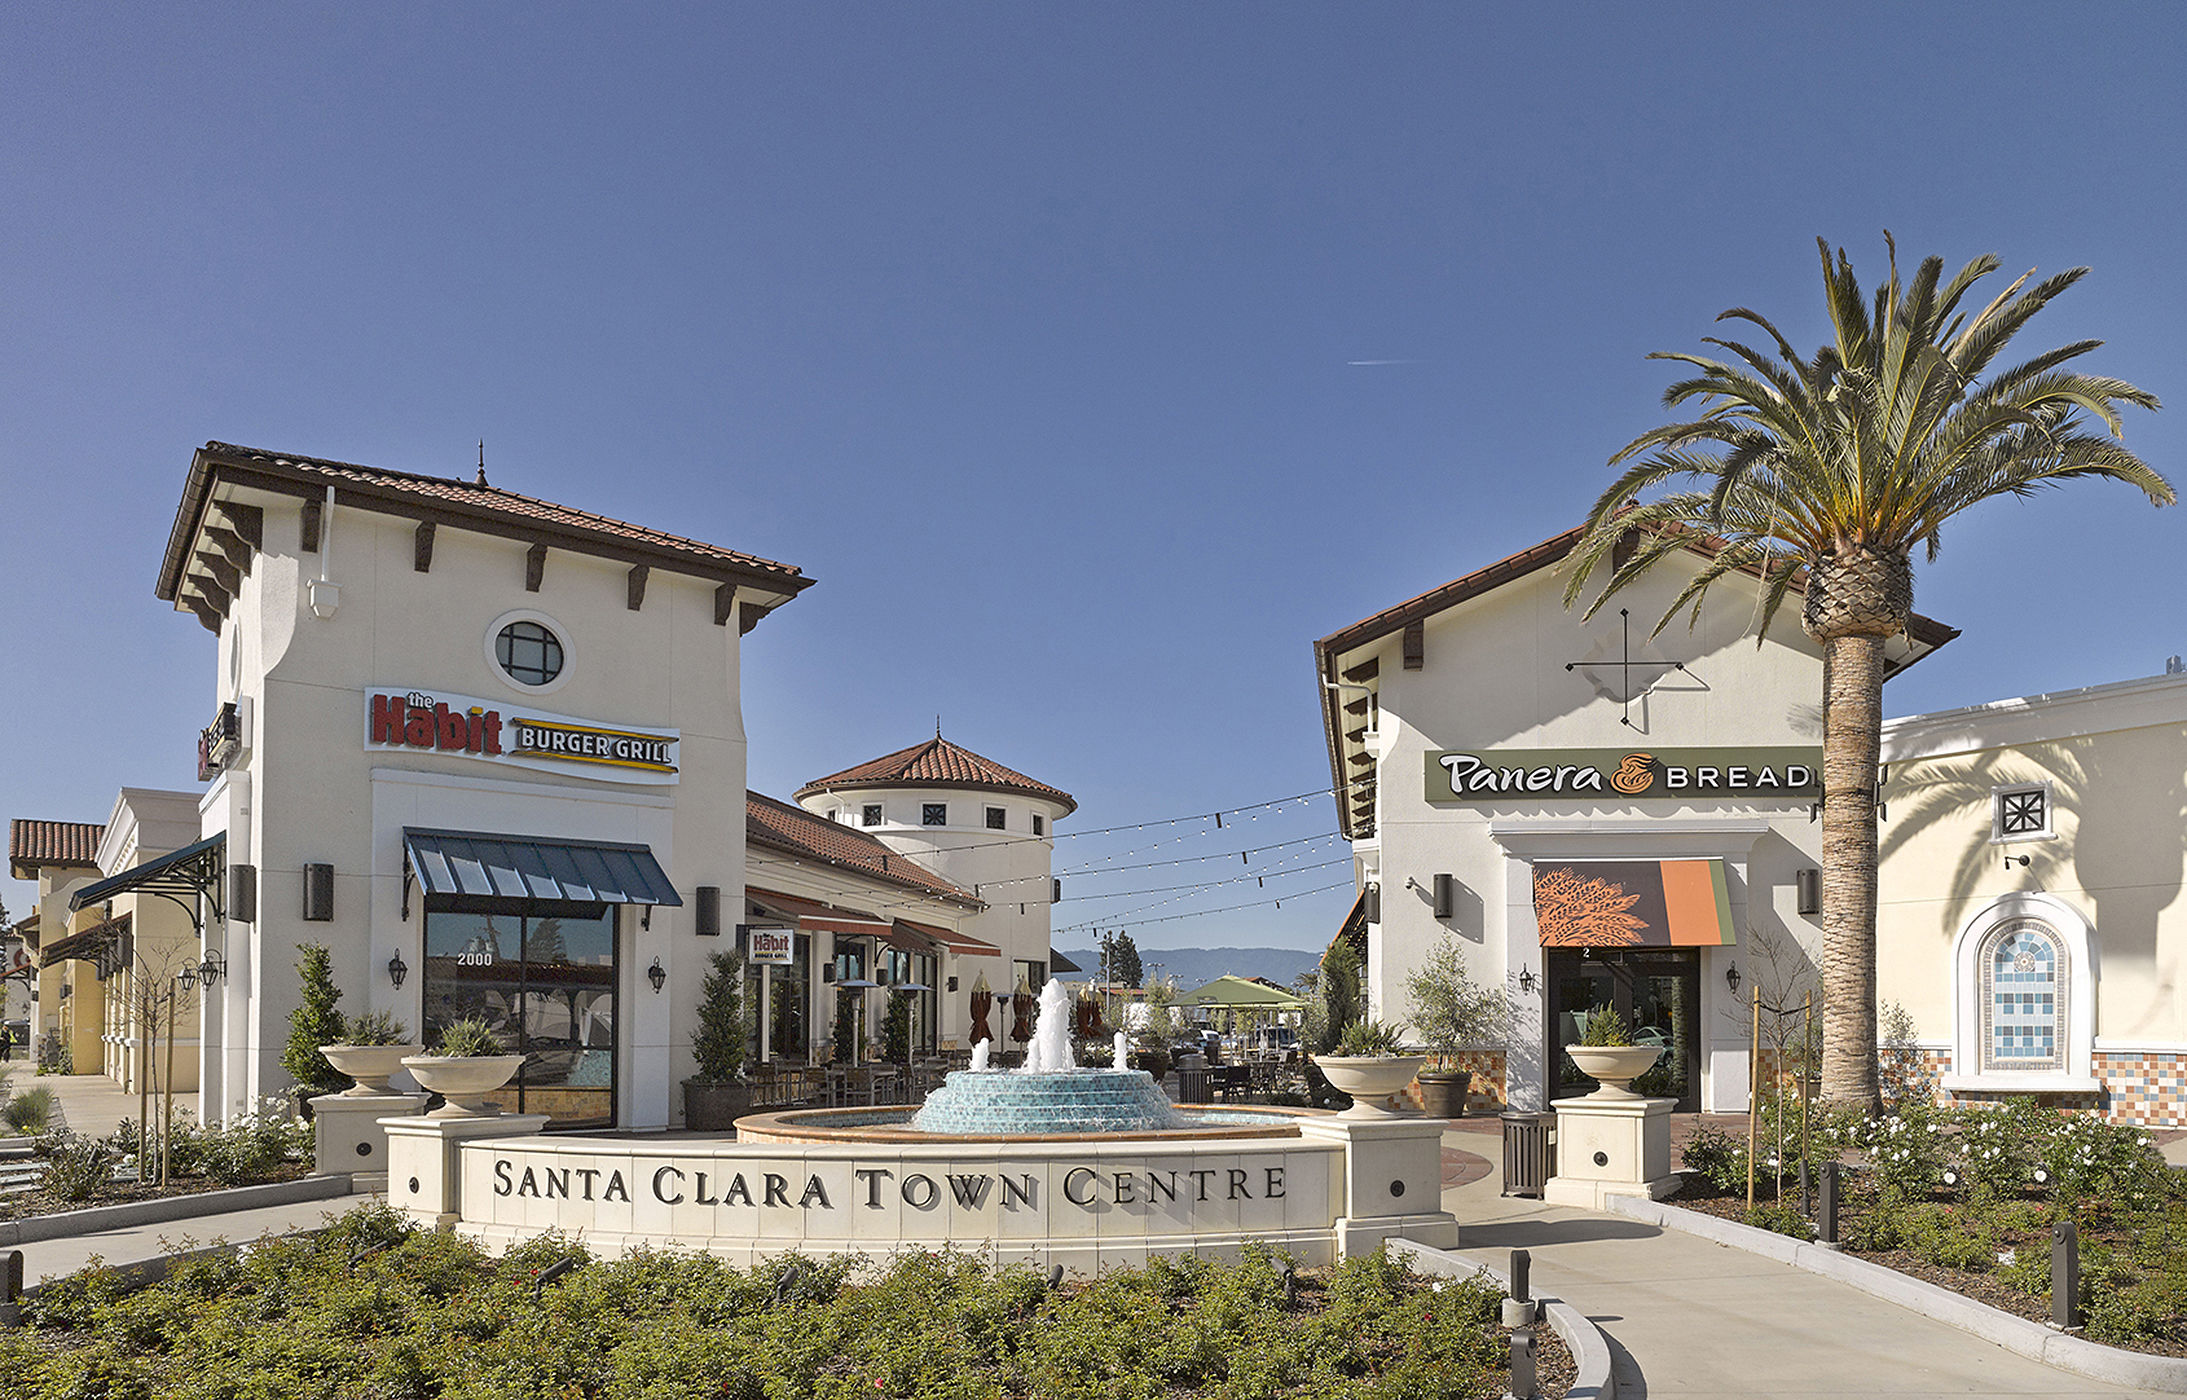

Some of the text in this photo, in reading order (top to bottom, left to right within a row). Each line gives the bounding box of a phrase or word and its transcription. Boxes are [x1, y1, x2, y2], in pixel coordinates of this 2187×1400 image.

[408, 692, 434, 708] the
[371, 694, 673, 764] Habit BURGER GRILL
[1439, 754, 1811, 793] Panera BREAD
[753, 934, 789, 951] Habit
[457, 952, 493, 966] 2000
[1583, 947, 1590, 958] 2
[494, 1160, 1287, 1210] SANTA CLARA TOWN CENTRE
